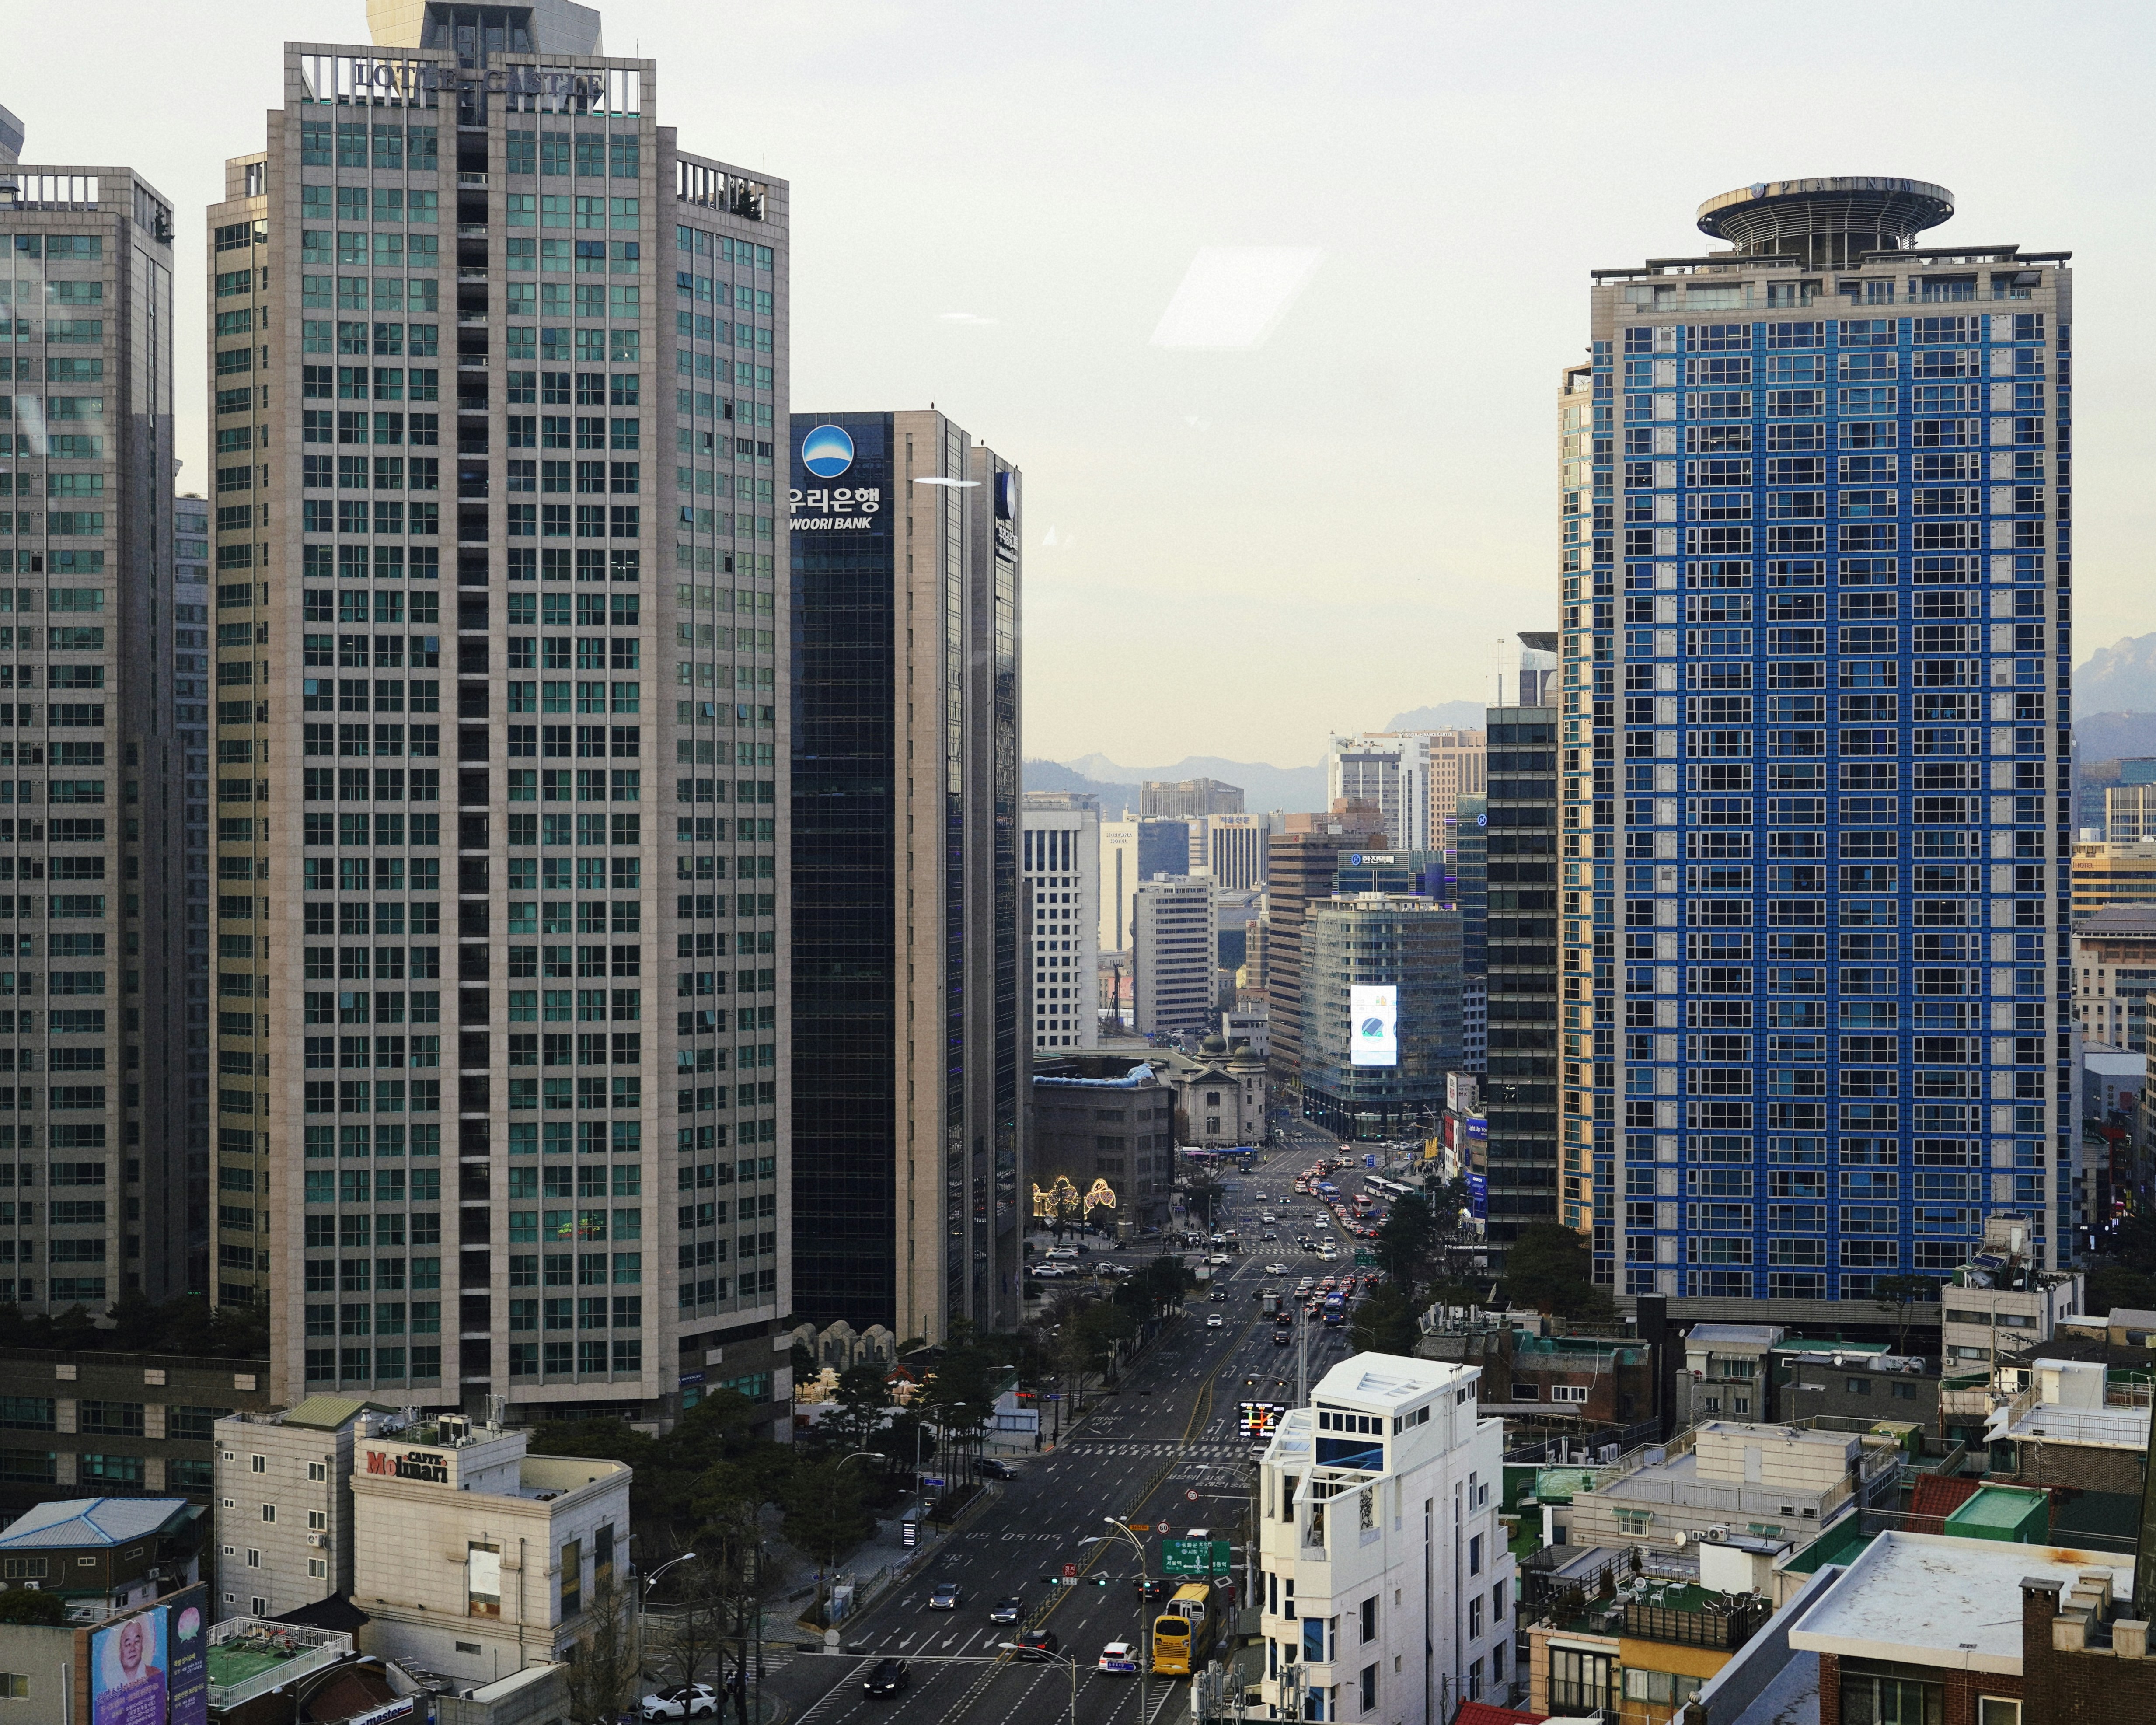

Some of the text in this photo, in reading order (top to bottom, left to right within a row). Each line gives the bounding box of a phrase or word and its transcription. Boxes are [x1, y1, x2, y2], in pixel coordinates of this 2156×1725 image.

[355, 64, 603, 97] LOTTE CASTLE
[789, 487, 879, 513] 우리은행
[789, 517, 872, 530] WOORI BANK
[1362, 856, 1394, 864] 한진택배
[367, 1451, 448, 1484] Molinari
[366, 1707, 401, 1725] master
